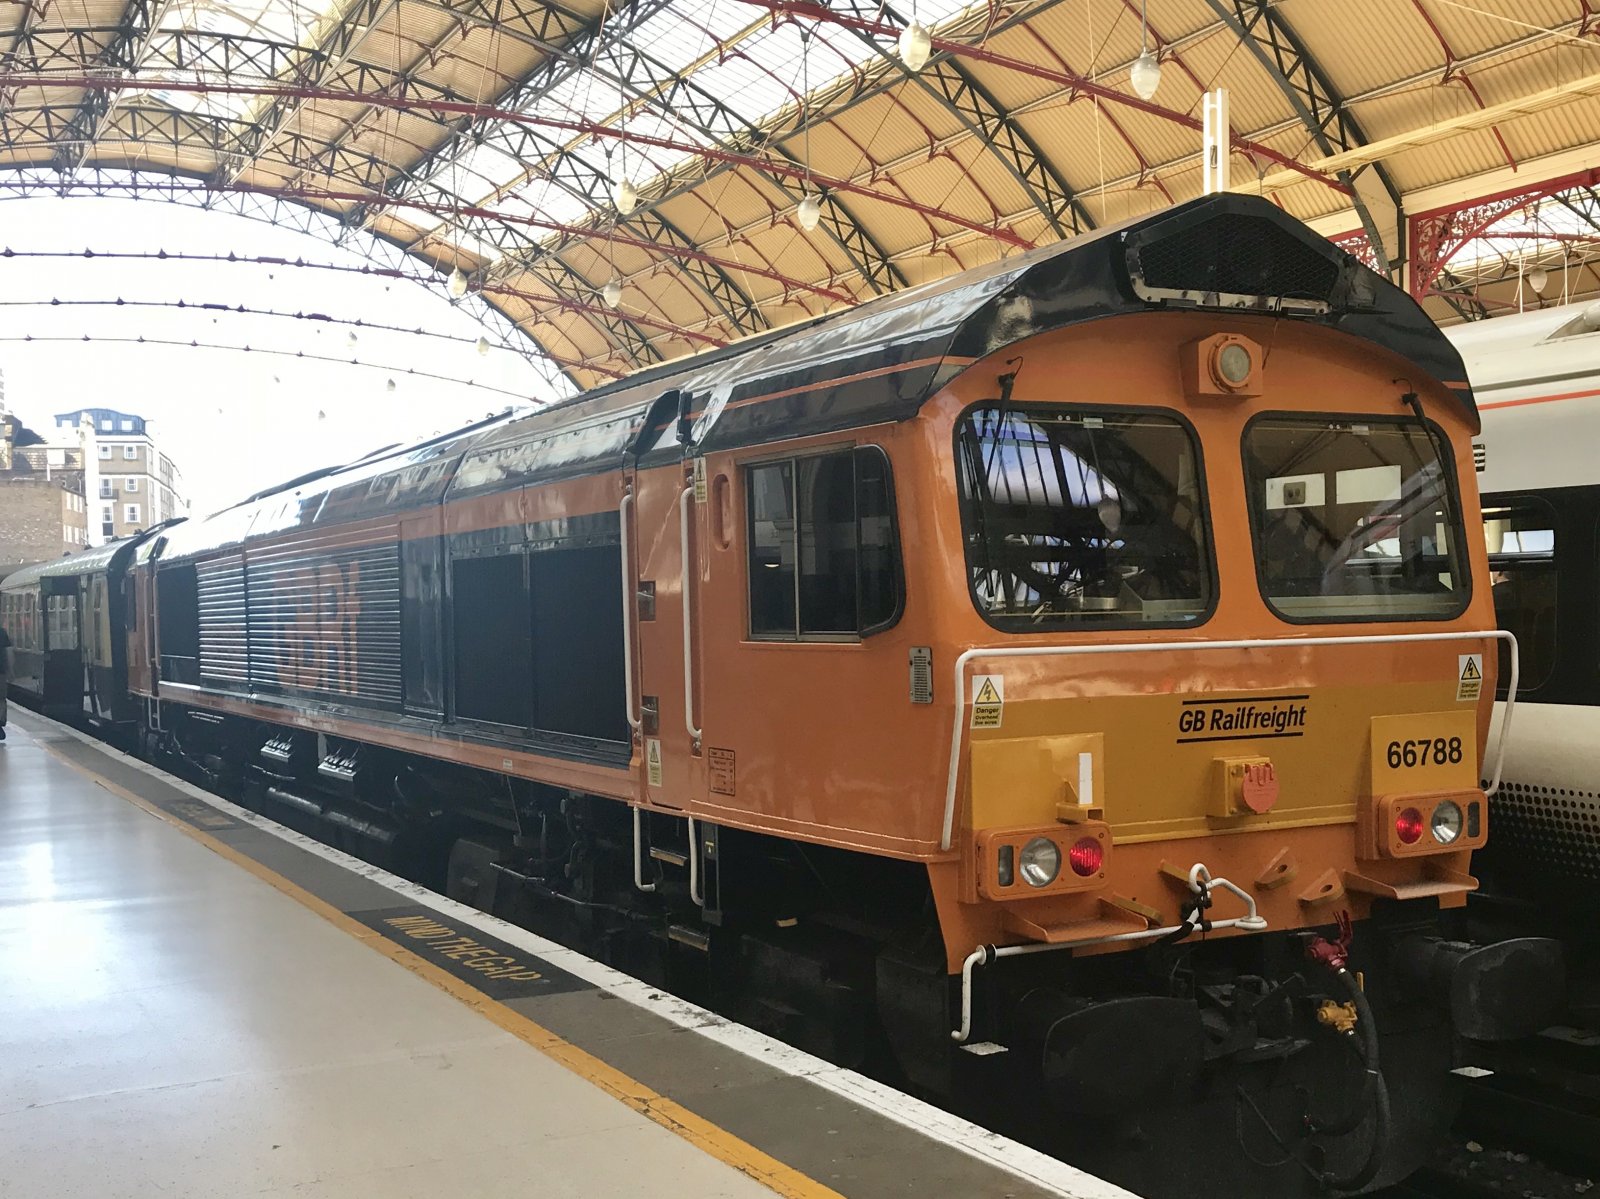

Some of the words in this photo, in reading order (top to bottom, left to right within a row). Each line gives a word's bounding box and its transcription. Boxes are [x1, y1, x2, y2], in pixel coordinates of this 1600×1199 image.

[272, 559, 361, 696] GBRf
[1179, 709, 1206, 733] GB
[1209, 704, 1307, 733] Railfreight
[1387, 736, 1463, 769] 66788
[383, 915, 456, 939] MIND
[426, 936, 499, 960] THE
[462, 956, 542, 981] GAP
